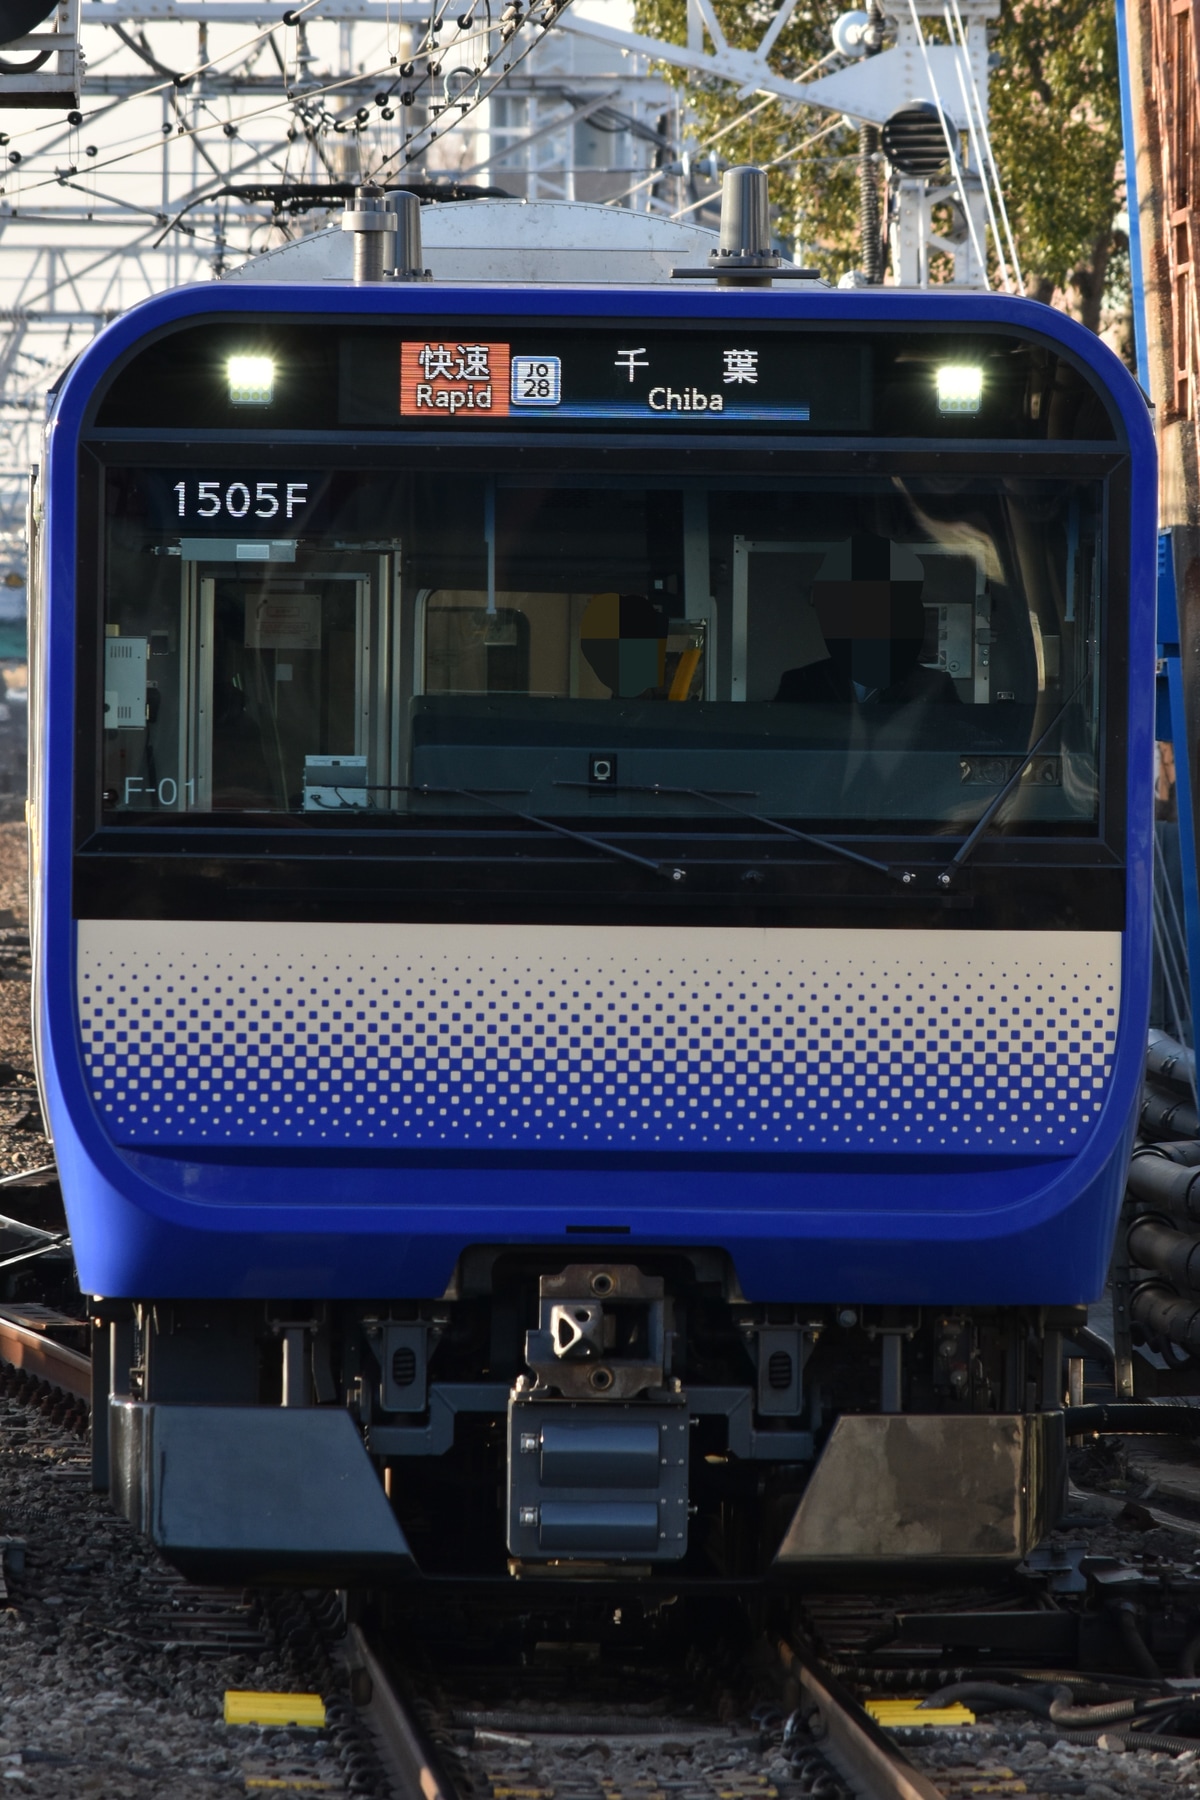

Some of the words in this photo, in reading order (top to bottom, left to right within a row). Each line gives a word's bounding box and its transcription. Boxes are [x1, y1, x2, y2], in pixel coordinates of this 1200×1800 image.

[418, 344, 491, 382] 快速
[526, 362, 550, 379] JO
[416, 384, 492, 413] Rapid
[523, 379, 551, 398] 28
[648, 387, 724, 412] Chiba
[173, 481, 309, 519] 1505F
[124, 777, 196, 805] F-01
